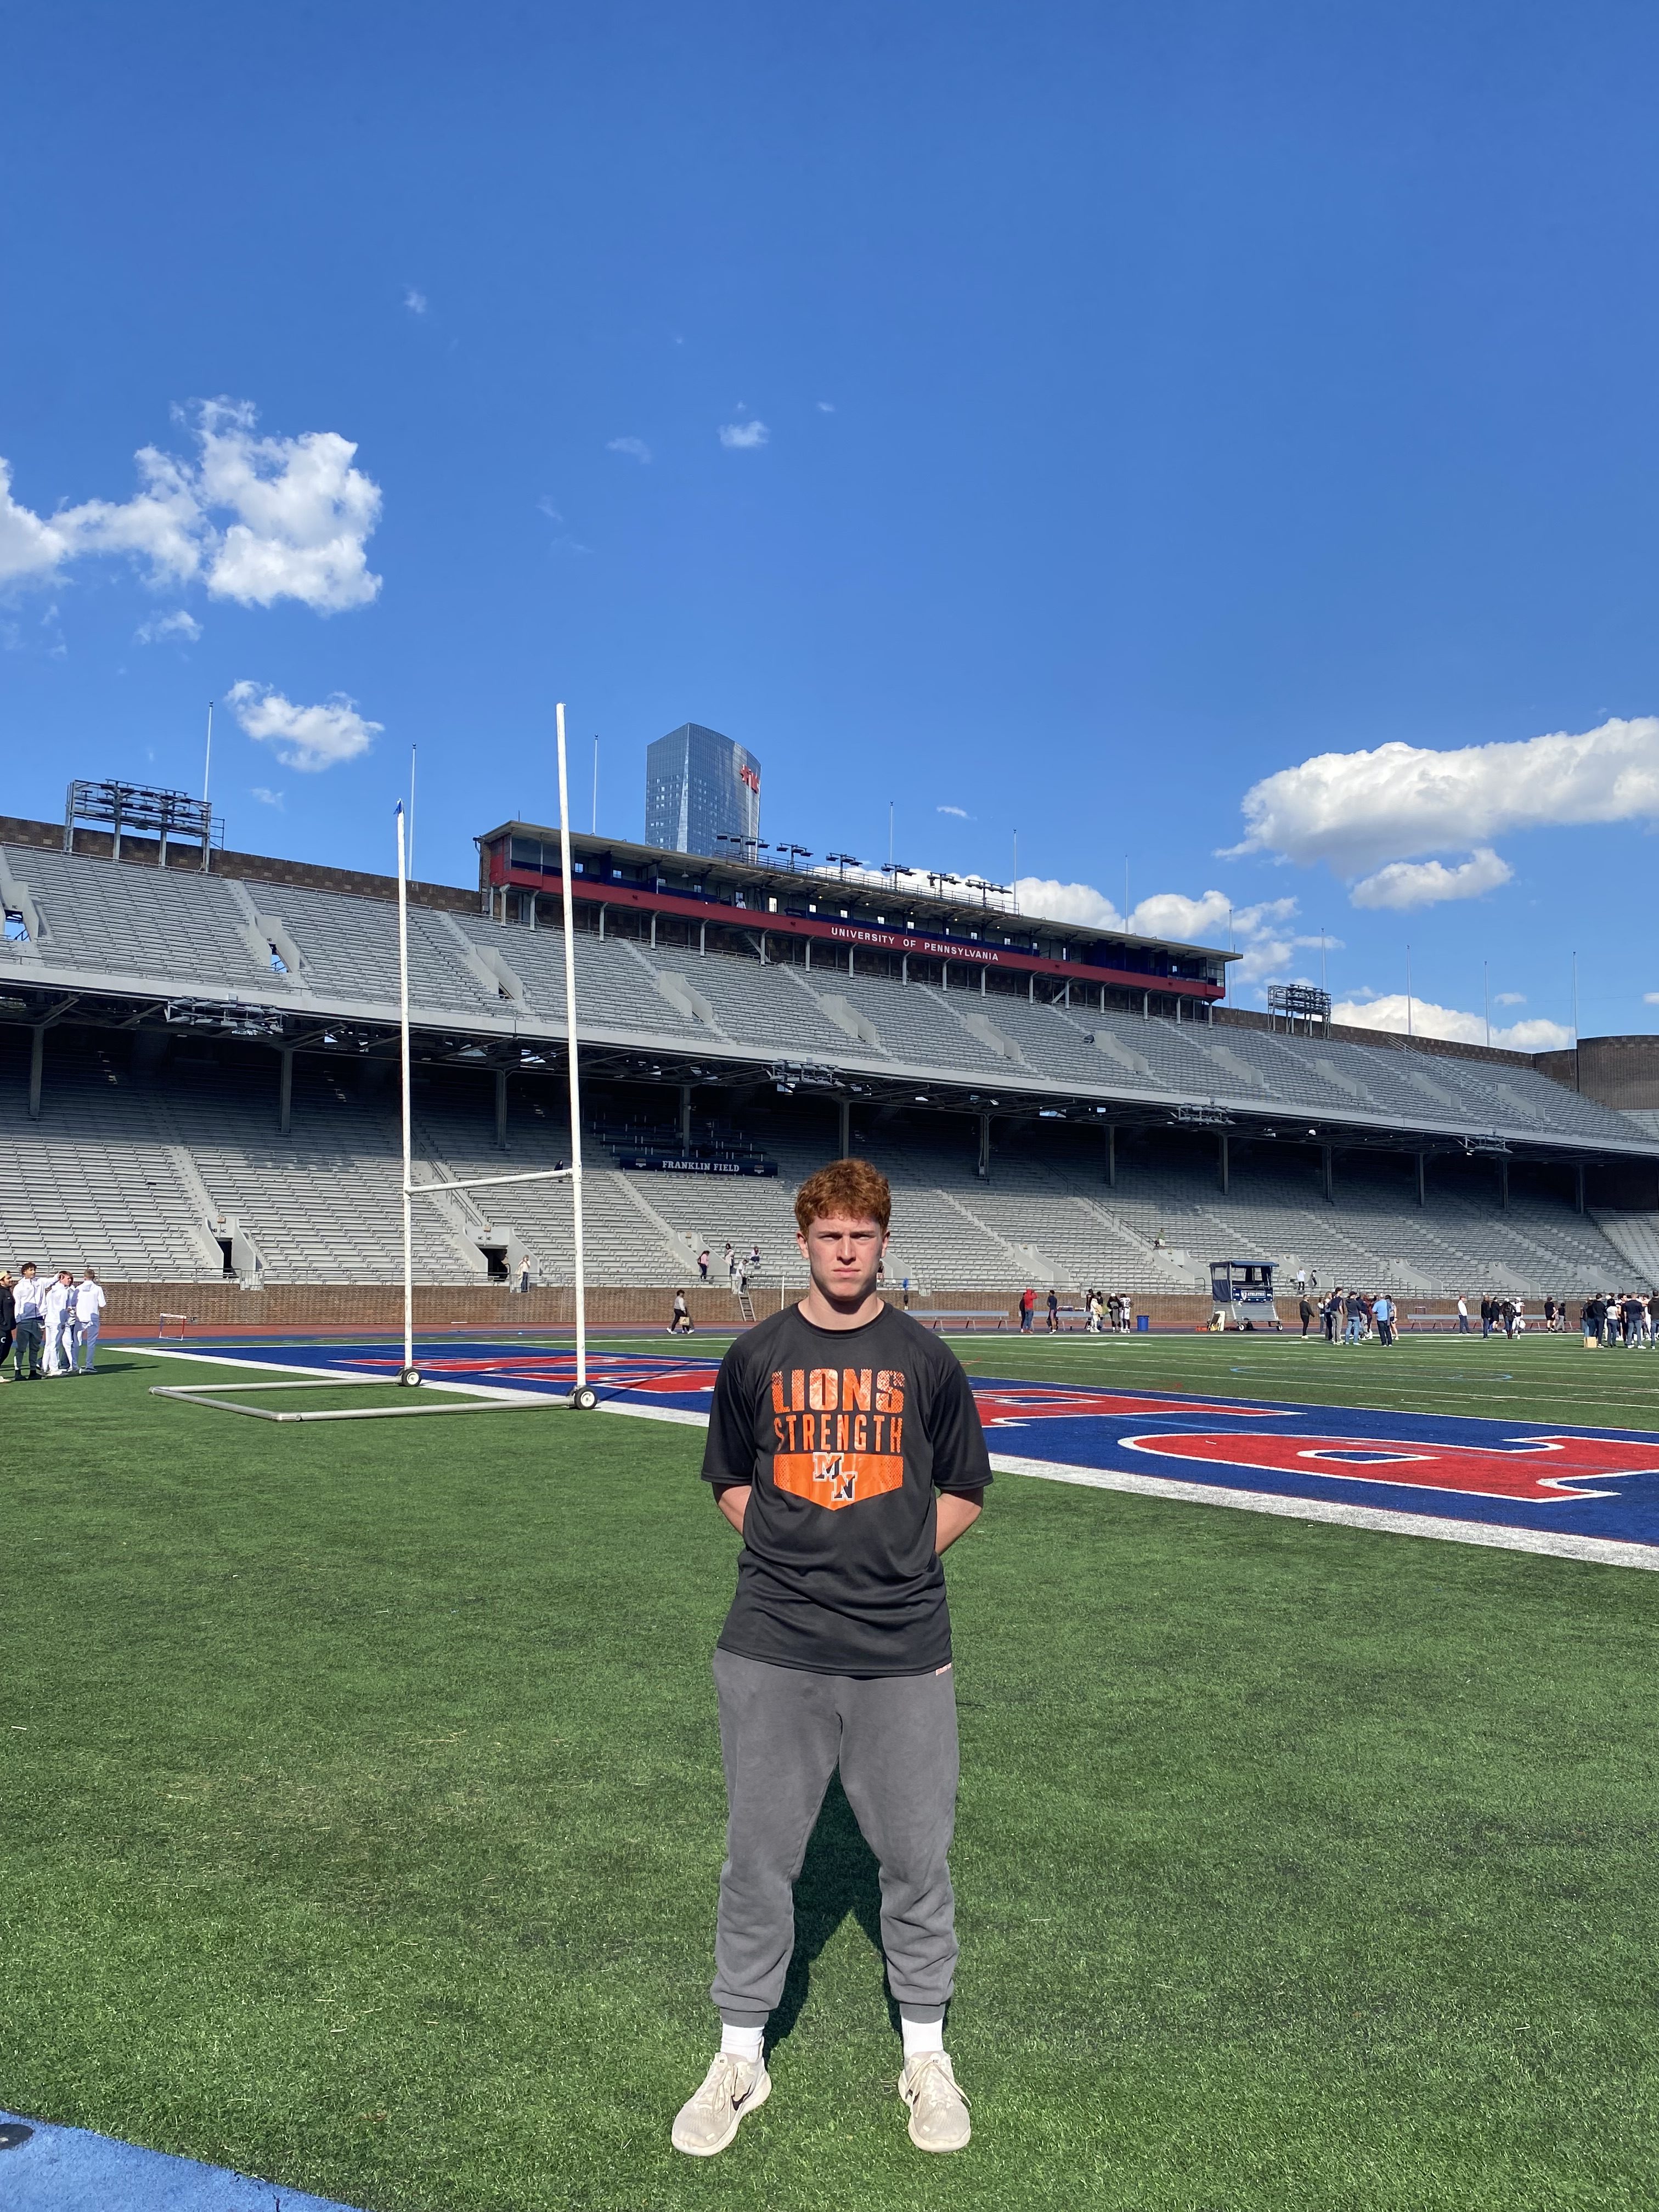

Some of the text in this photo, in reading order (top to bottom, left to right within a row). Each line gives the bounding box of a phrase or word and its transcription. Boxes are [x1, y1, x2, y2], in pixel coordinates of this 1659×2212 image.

[831, 927, 998, 961] UNIVERSITY OF PENNSYLVANIA
[662, 1160, 740, 1172] FRANKLIN FIELD
[771, 1368, 905, 1414] LIONS
[774, 1413, 903, 1453] STRENGTH
